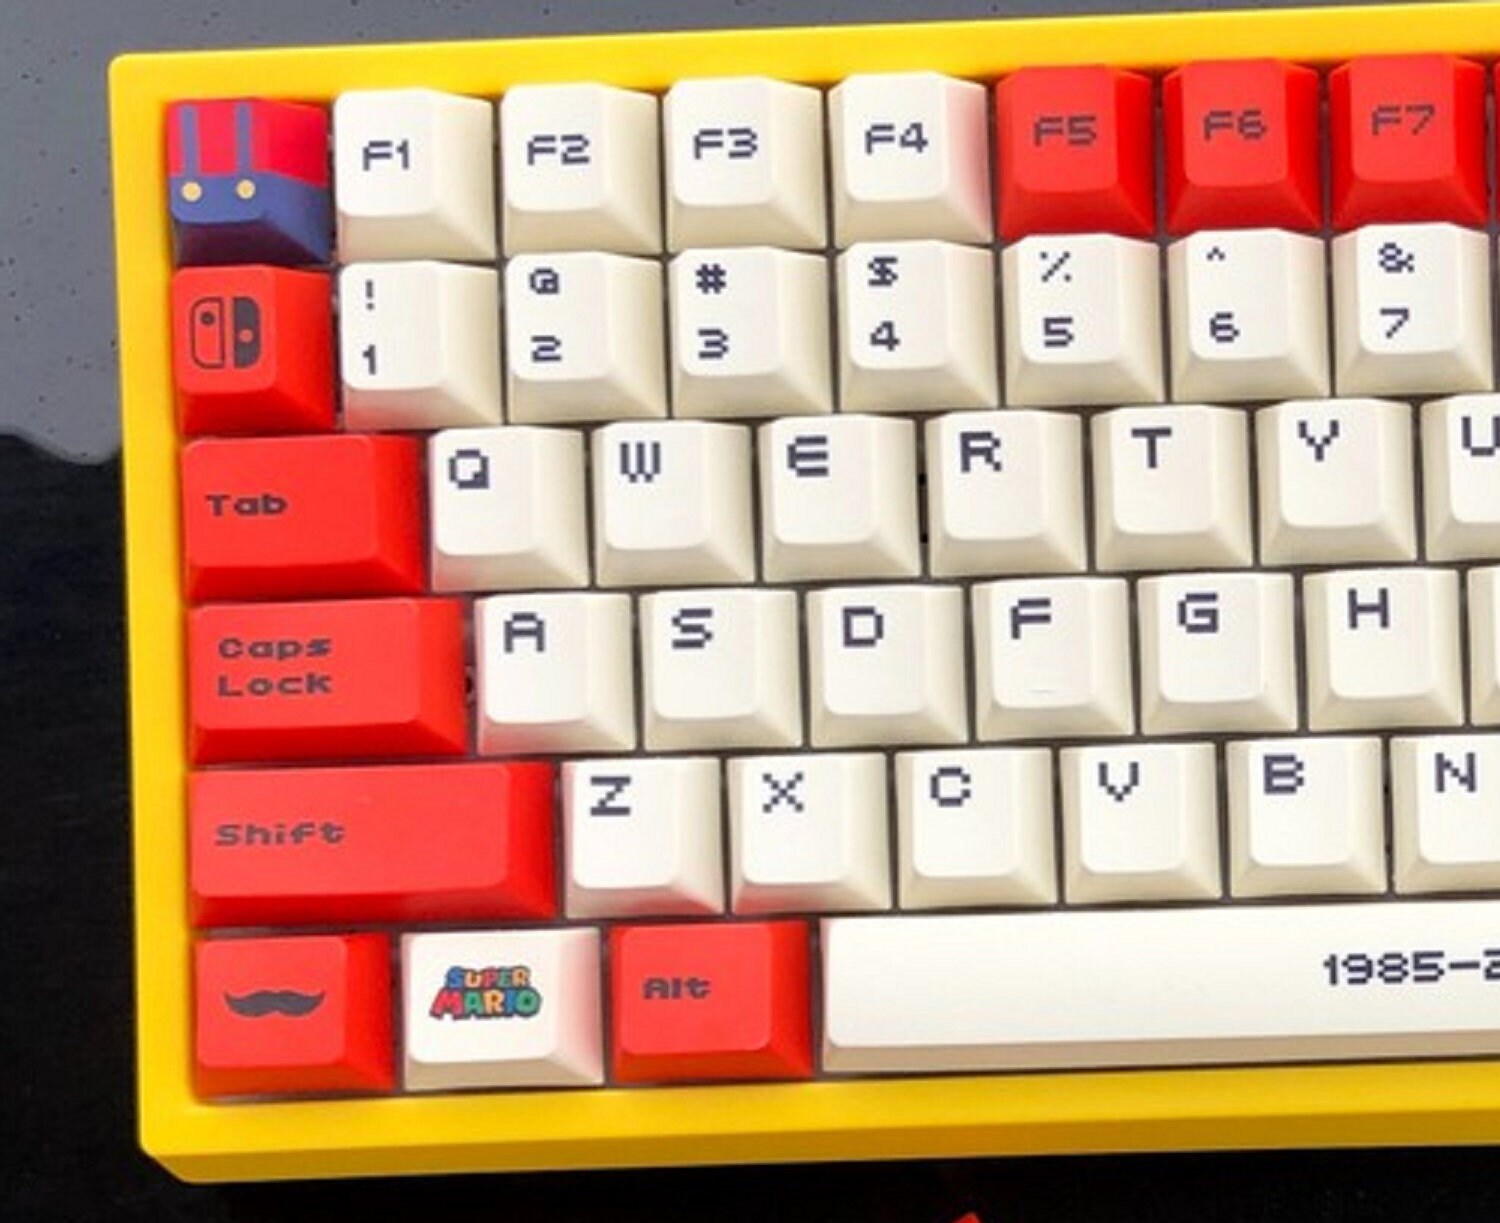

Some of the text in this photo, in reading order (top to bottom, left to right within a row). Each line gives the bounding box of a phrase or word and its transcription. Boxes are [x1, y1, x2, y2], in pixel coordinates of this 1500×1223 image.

[1033, 113, 1097, 146] F5
[1201, 108, 1267, 141] F6
[1370, 102, 1435, 136] F7
[528, 134, 589, 165] F2
[694, 128, 757, 159] F3
[865, 123, 928, 154] F4
[363, 140, 409, 171] F1
[868, 257, 898, 286] $
[1041, 252, 1071, 282] %
[1379, 243, 1414, 272] &
[530, 268, 559, 294] @
[696, 264, 726, 294] #
[870, 321, 900, 351] 4
[1044, 317, 1074, 347] 5
[1210, 313, 1239, 342] 6
[1380, 308, 1409, 338] 7
[363, 345, 376, 375] 1
[532, 336, 561, 362] 2
[698, 329, 728, 359] 3
[787, 436, 828, 477] E
[960, 431, 1001, 472] R
[1132, 427, 1172, 468] T
[1299, 420, 1339, 461] Y
[449, 449, 489, 489] Q
[620, 442, 660, 483] W
[205, 494, 287, 516] Tab
[1011, 598, 1051, 639] F
[1178, 593, 1218, 633] G
[1348, 588, 1389, 629] H
[504, 613, 544, 653] A
[672, 608, 712, 649] S
[843, 607, 883, 647] D
[219, 637, 331, 661] Caps
[217, 673, 331, 697] Lock
[930, 767, 971, 807] C
[1099, 762, 1139, 802] V
[1264, 755, 1304, 794] B
[1435, 752, 1476, 793] N
[590, 776, 631, 816] Z
[763, 772, 803, 813] X
[216, 822, 344, 846] Shift
[445, 966, 531, 989] SUPER
[643, 977, 710, 999] Alt
[429, 987, 542, 1020] MARIO
